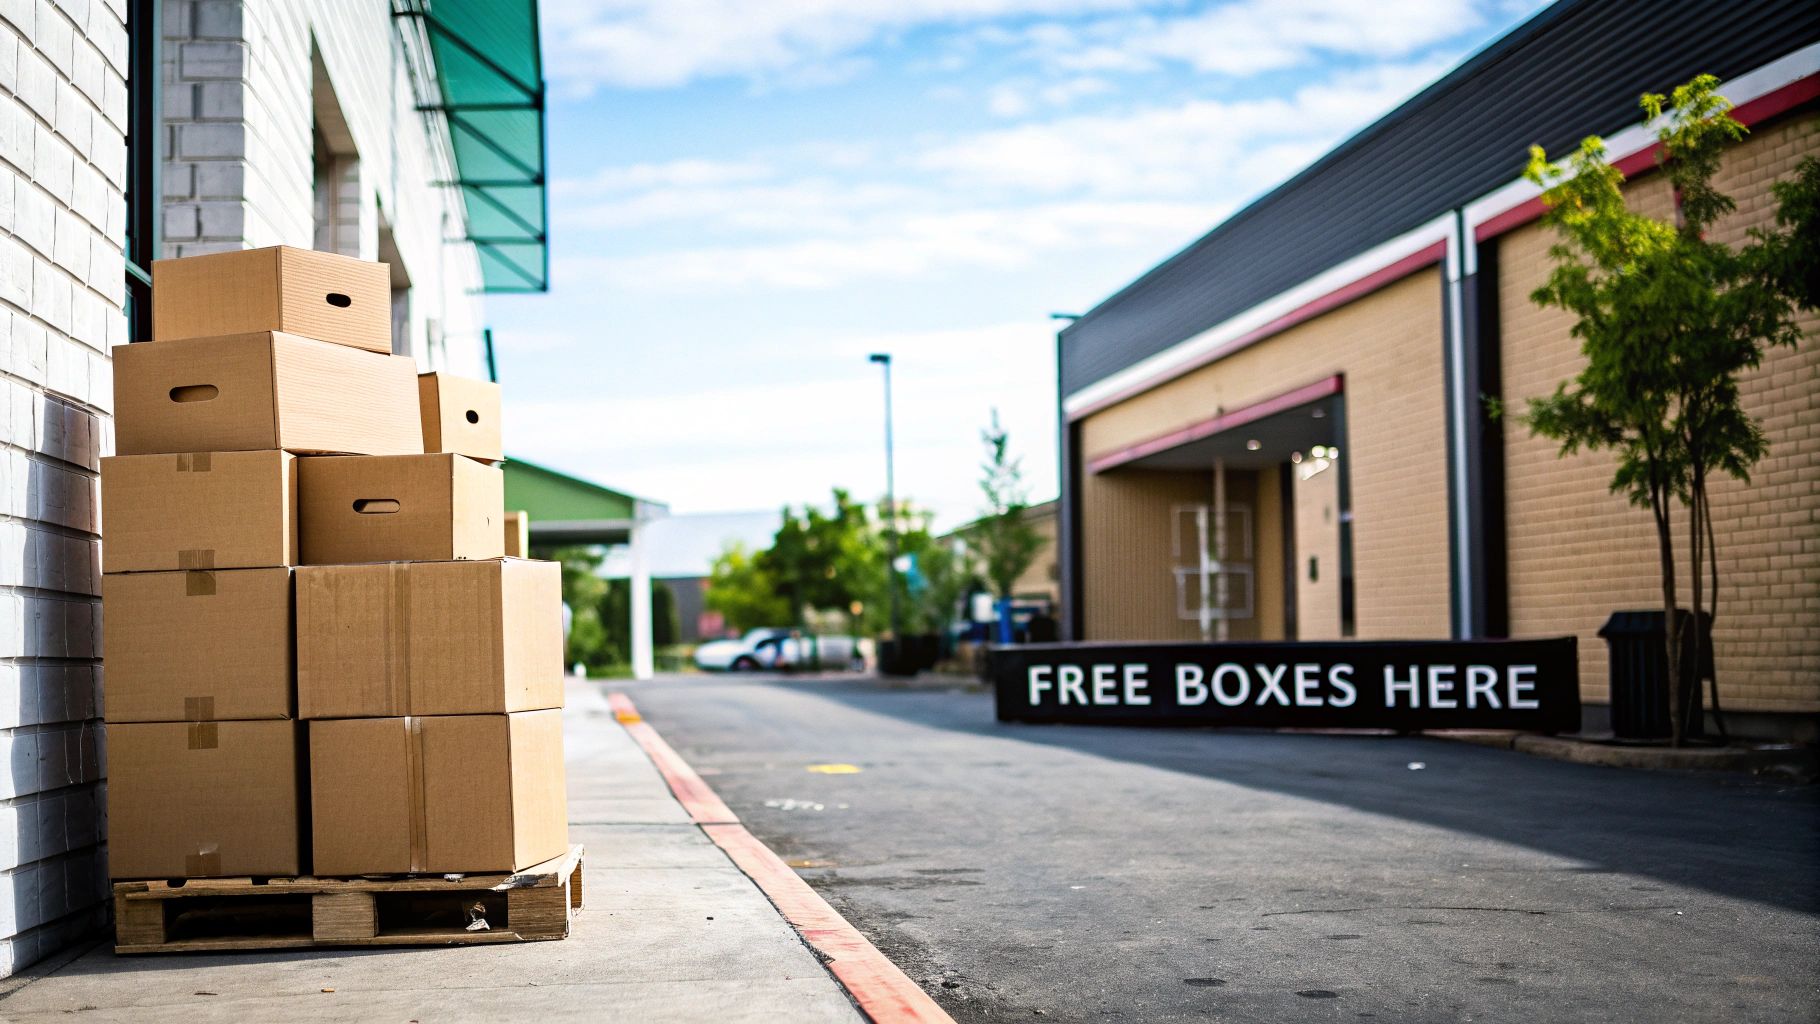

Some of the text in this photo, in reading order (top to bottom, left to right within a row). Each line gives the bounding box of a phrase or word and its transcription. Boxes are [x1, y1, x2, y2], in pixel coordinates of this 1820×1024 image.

[1029, 664, 1540, 709] FREE BOXES HERE
